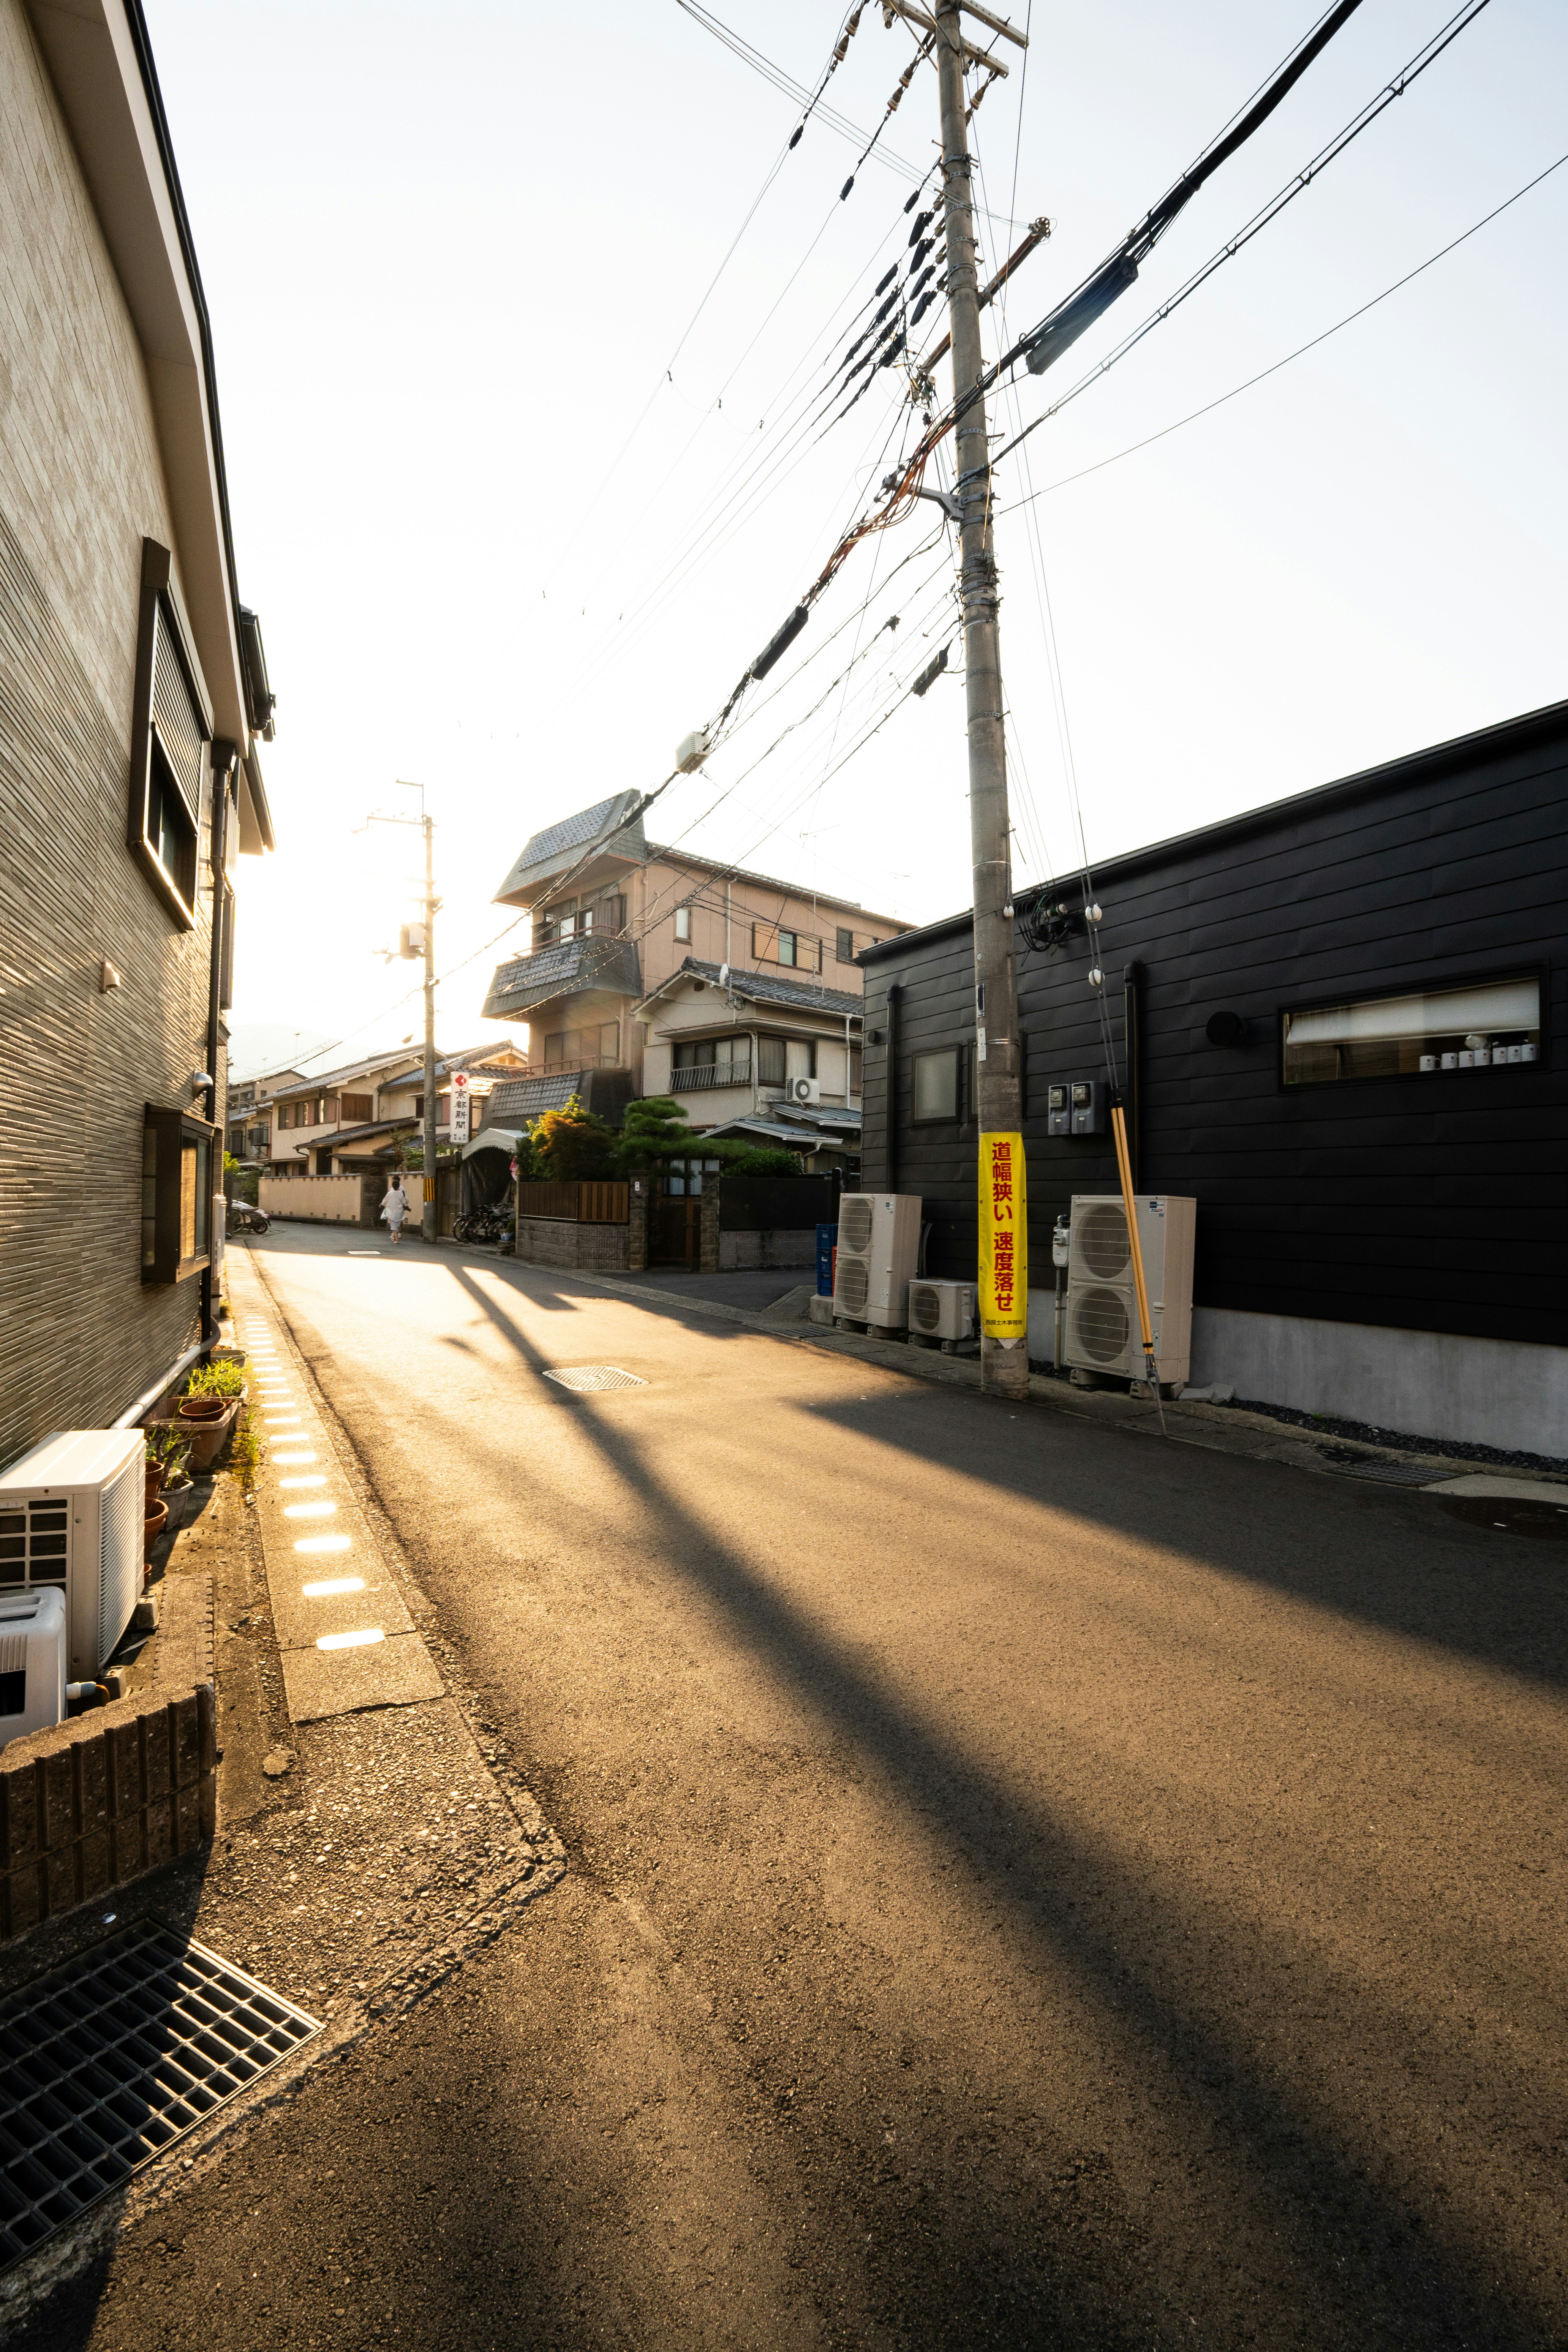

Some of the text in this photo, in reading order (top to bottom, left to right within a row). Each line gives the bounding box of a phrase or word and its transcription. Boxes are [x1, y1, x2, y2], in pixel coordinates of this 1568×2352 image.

[992, 1141, 1014, 1312] 道幅狭い 速度落せ
